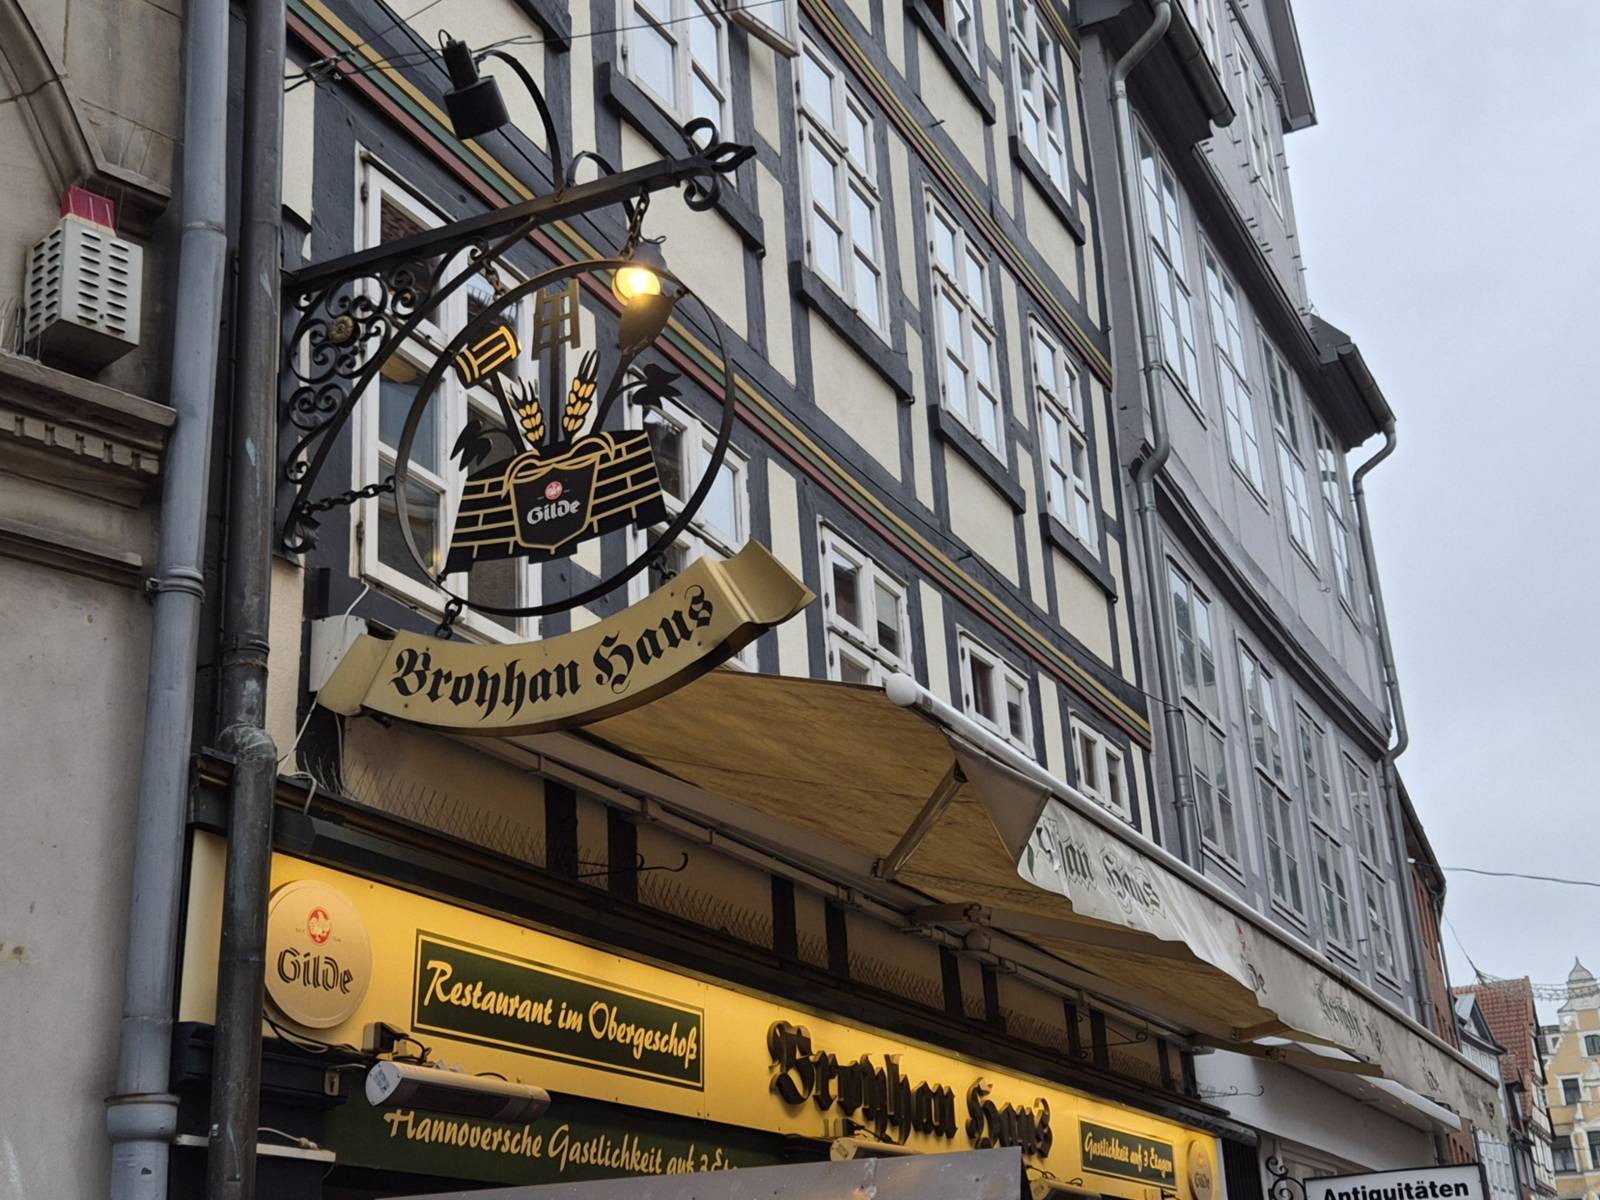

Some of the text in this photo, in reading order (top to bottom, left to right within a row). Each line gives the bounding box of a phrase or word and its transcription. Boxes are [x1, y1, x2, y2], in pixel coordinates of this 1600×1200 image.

[527, 500, 580, 525] Gilde
[389, 583, 714, 721] Broyhan Haus
[277, 947, 353, 994] Gilde
[424, 960, 698, 1069] Restaurant im Obergeschoß
[383, 1109, 544, 1158] Hannoversche
[548, 1124, 663, 1172] Gastlichkeit
[1143, 1150, 1149, 1168] 3
[1323, 1181, 1469, 1200] Antiquitäten
